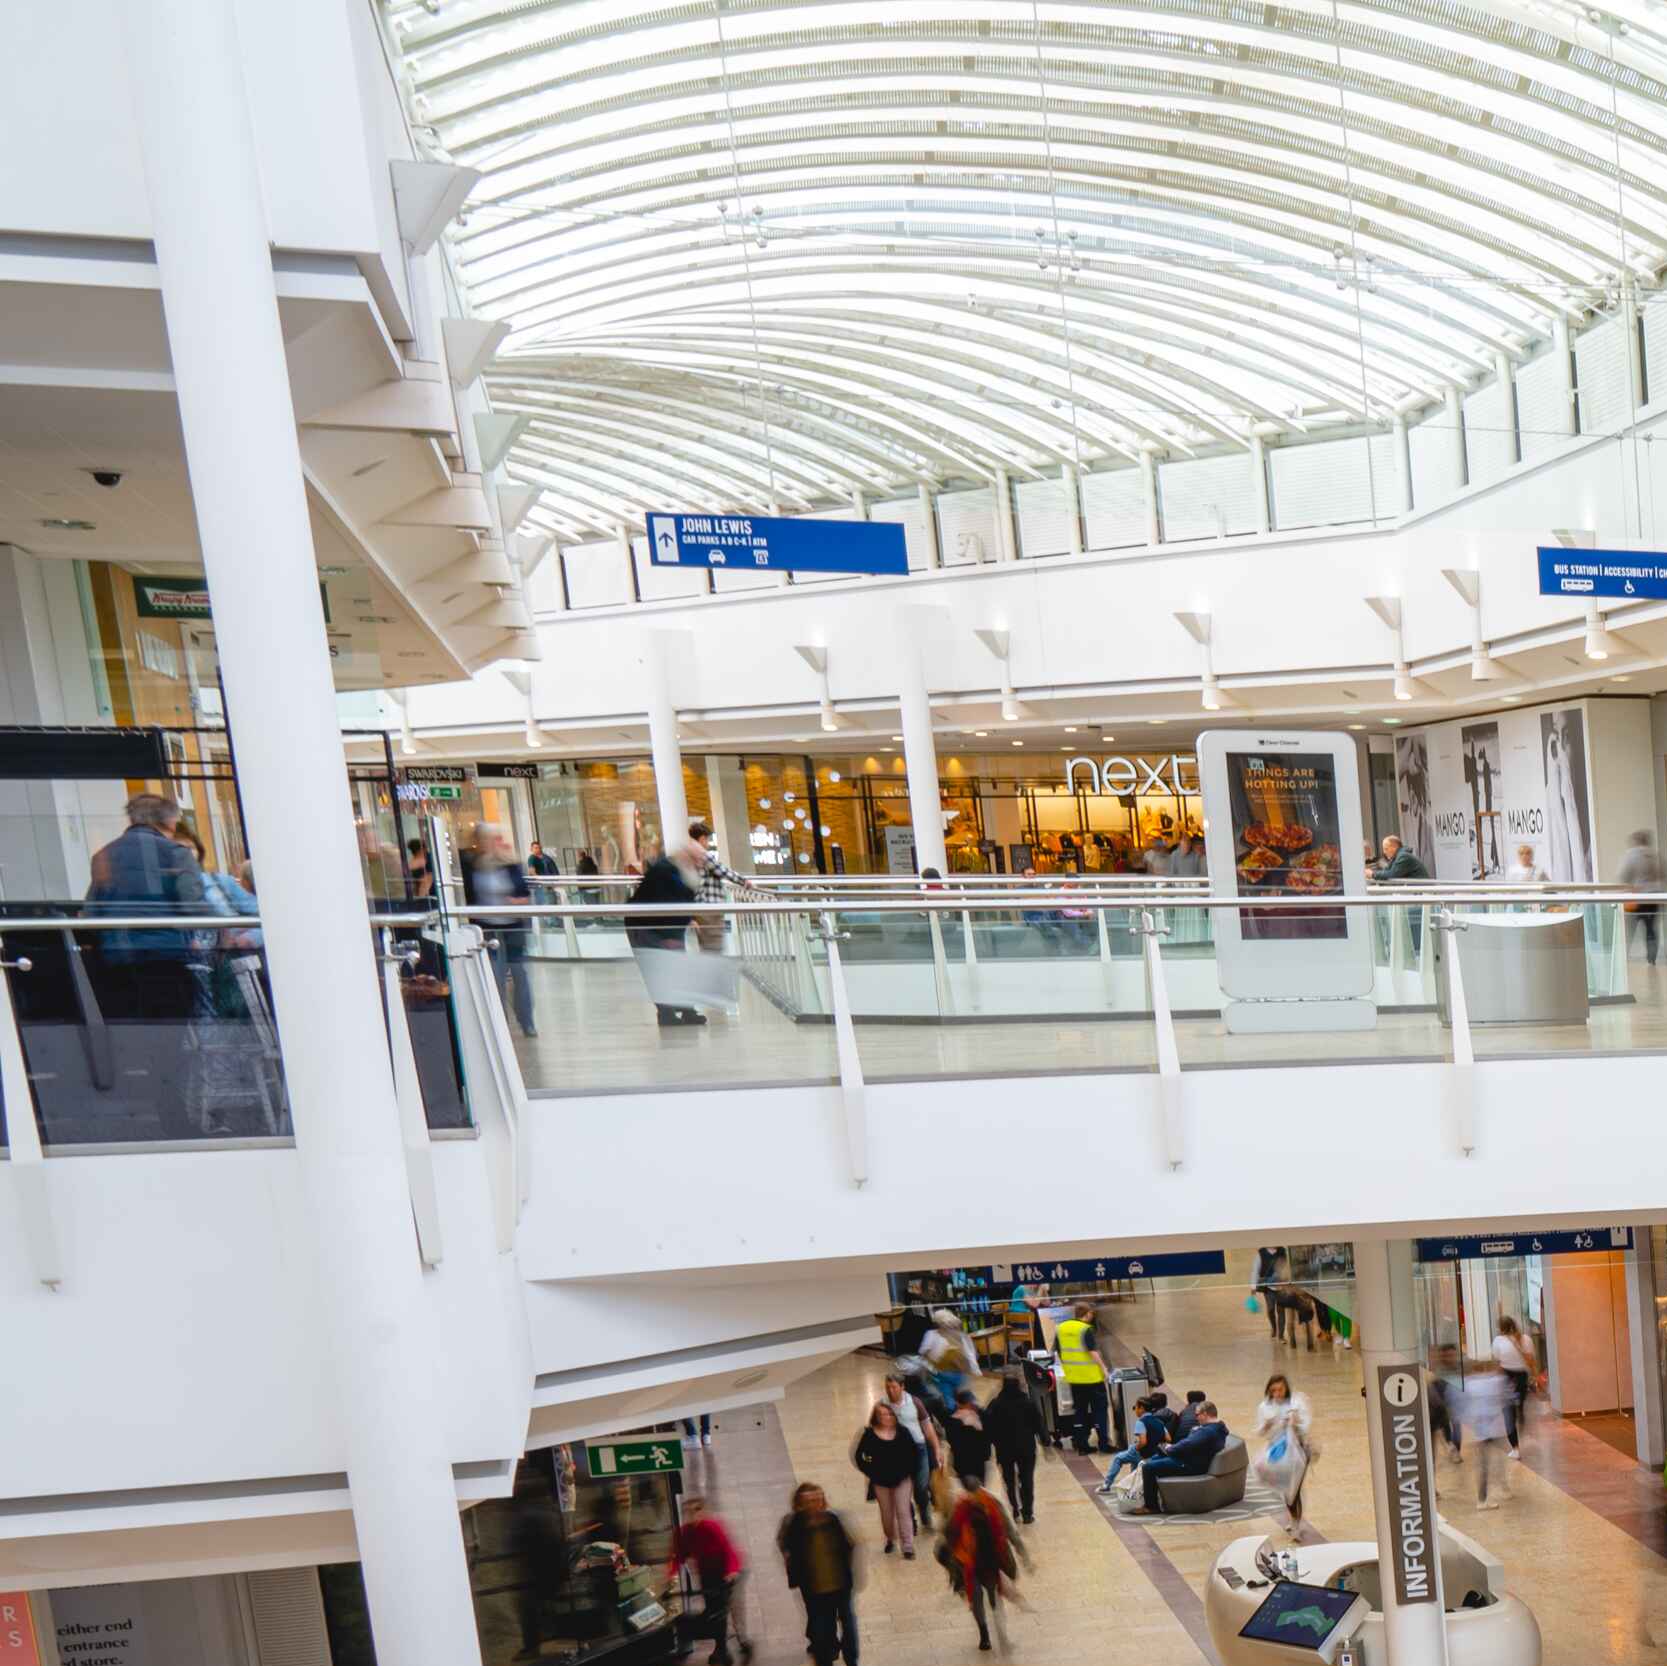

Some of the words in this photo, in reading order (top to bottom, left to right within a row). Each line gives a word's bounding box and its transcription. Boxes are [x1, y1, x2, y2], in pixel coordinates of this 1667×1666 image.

[681, 518, 712, 533] JOHN
[715, 520, 752, 535] LEWIS
[682, 535, 696, 544] CAR
[698, 536, 719, 545] PARKS
[1554, 564, 1569, 575] BUS
[1570, 565, 1598, 575] STATION
[1604, 567, 1653, 579] ACCESSIBILITY
[503, 766, 536, 777] next
[1065, 754, 1200, 796] next
[1293, 768, 1315, 777] ARE
[1245, 780, 1297, 789] HOTTING
[1435, 812, 1465, 837] MANGO
[1508, 808, 1544, 834] MANGO
[1393, 1414, 1428, 1599] INFORMATION
[57, 1622, 100, 1637] either
[105, 1618, 133, 1632] end
[64, 1639, 129, 1653] entrance
